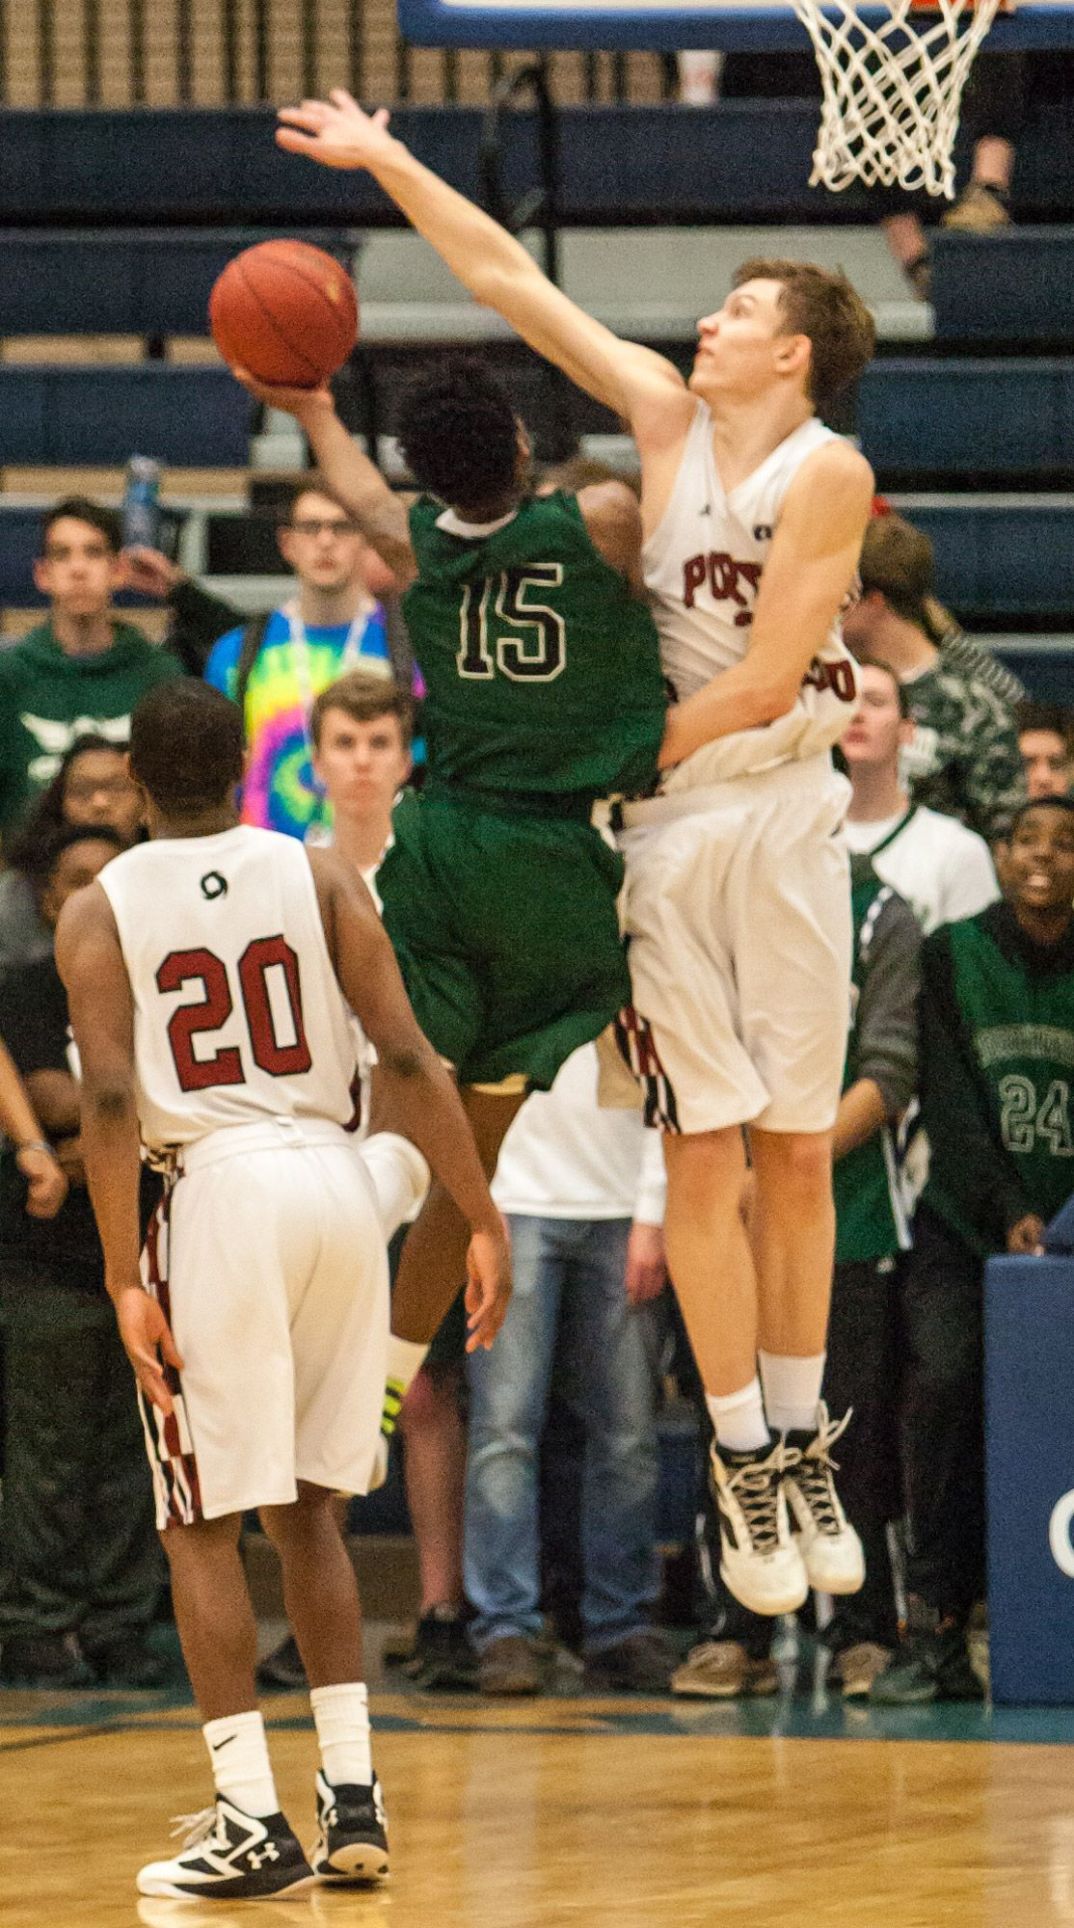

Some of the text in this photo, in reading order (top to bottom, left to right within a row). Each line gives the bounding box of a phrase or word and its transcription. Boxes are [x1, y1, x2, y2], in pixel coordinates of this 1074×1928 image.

[456, 562, 566, 682] 15
[155, 933, 312, 1093] 20
[998, 1074, 1074, 1157] 24
